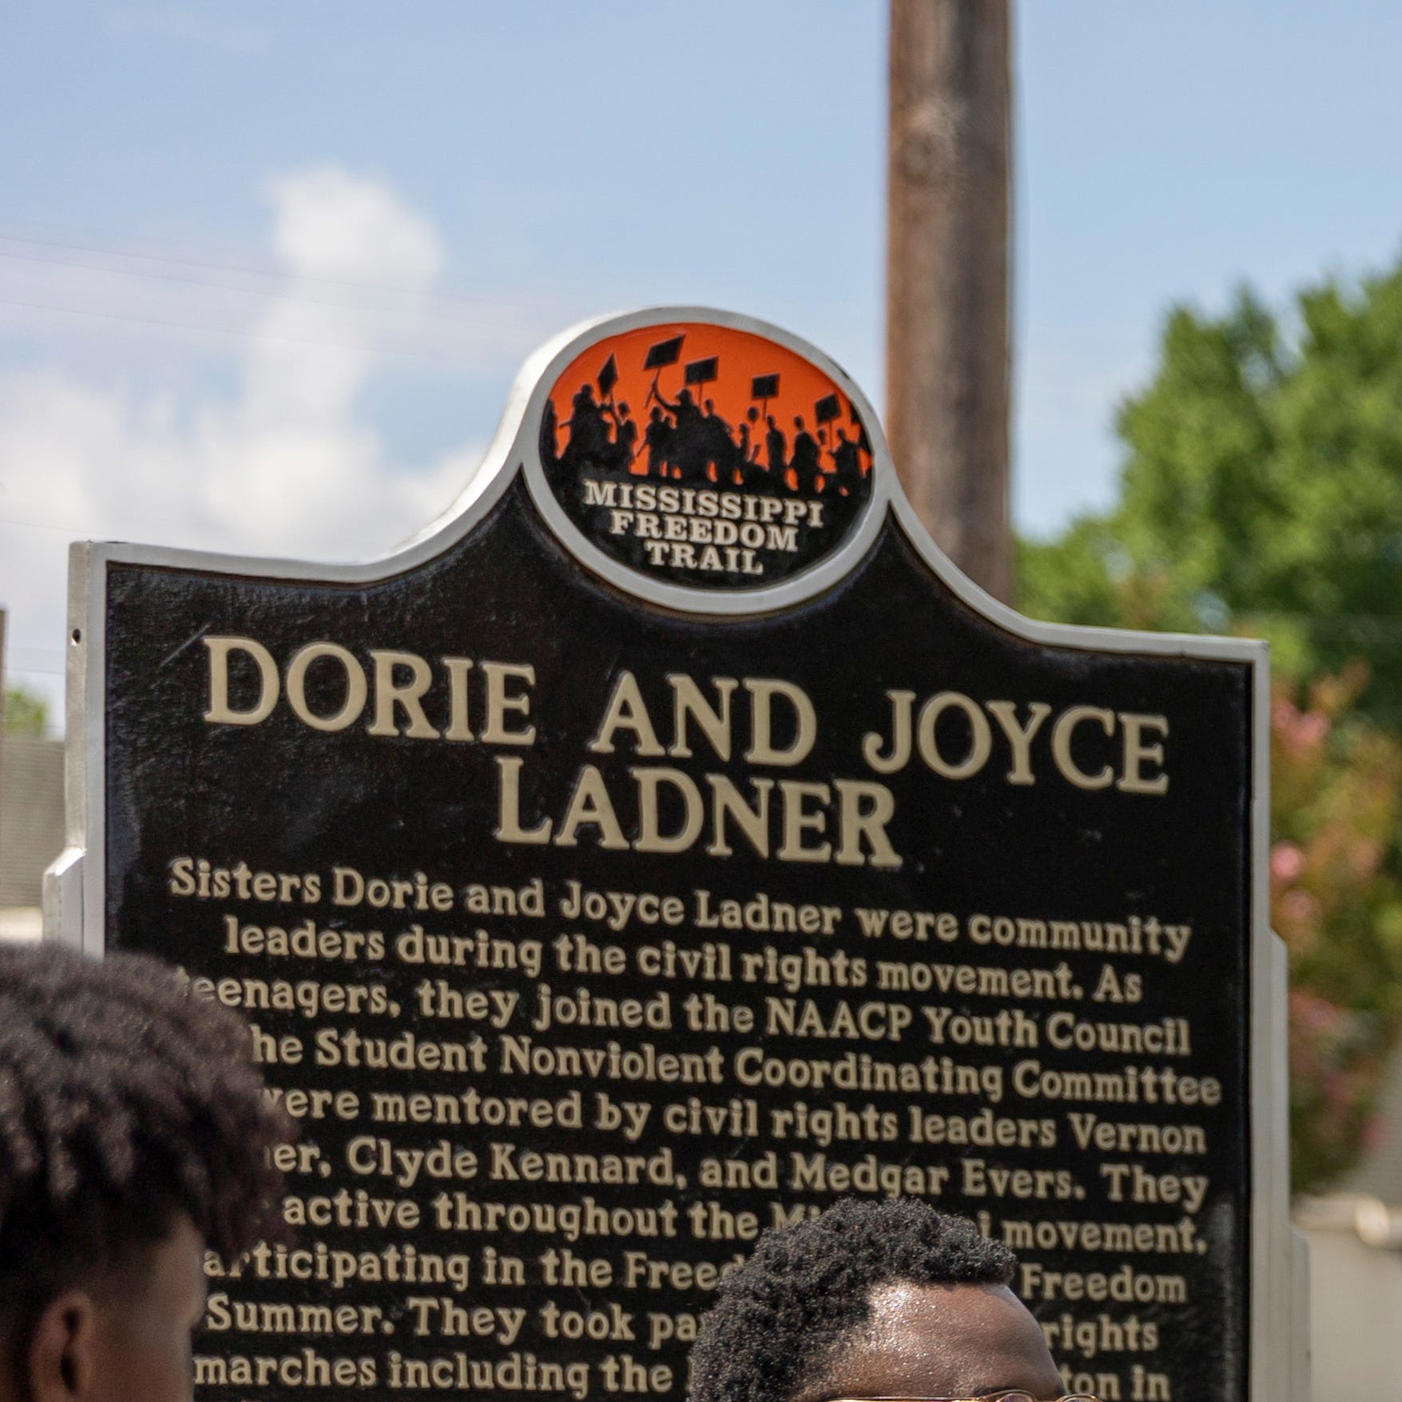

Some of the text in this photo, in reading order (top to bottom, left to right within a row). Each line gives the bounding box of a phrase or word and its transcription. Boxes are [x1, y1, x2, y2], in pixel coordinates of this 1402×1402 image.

[583, 478, 824, 528] MISSISSIPPI
[609, 509, 799, 552] FREEDOM
[644, 540, 765, 575] TRAIL
[201, 635, 1168, 795] DORIE AND JOYCE
[494, 757, 904, 866] LADNER
[169, 857, 1190, 961] Sisters Dorie and Joyce Ladner were community
[224, 915, 1141, 1001] leaders during the civil rights movement. As
[416, 980, 519, 1028] they
[533, 984, 672, 1030] joined
[684, 994, 753, 1032] the
[767, 998, 911, 1040] NAACP
[923, 1007, 1037, 1047] Youth
[1048, 1013, 1189, 1054] Council
[248, 1024, 1219, 1103] he Student Nonviolent Coordinating Committee
[372, 1088, 581, 1127] mentored
[595, 1093, 651, 1140] by
[666, 1098, 757, 1136] civil
[772, 1102, 897, 1146] rights
[911, 1106, 1055, 1146] leaders
[1070, 1113, 1205, 1152] Vernon
[348, 1136, 477, 1187] Clyde
[491, 1143, 686, 1189] Kennard,
[701, 1152, 777, 1188] and
[791, 1153, 948, 1199] Medgar
[963, 1160, 1084, 1198] Evers.
[1102, 1164, 1206, 1212] They
[283, 1189, 419, 1228] active
[432, 1192, 677, 1241] throughout
[688, 1202, 758, 1239] the
[1002, 1219, 1207, 1255] movement.
[203, 1240, 1187, 1303] articipating in the Free Freedom
[207, 1293, 393, 1333] Summer.
[408, 1297, 526, 1345] They
[540, 1301, 635, 1340] took
[1041, 1314, 1160, 1358] rights
[192, 1348, 376, 1386] marches
[389, 1351, 589, 1399] including
[600, 1355, 672, 1392] the
[1133, 1365, 1169, 1400] in
